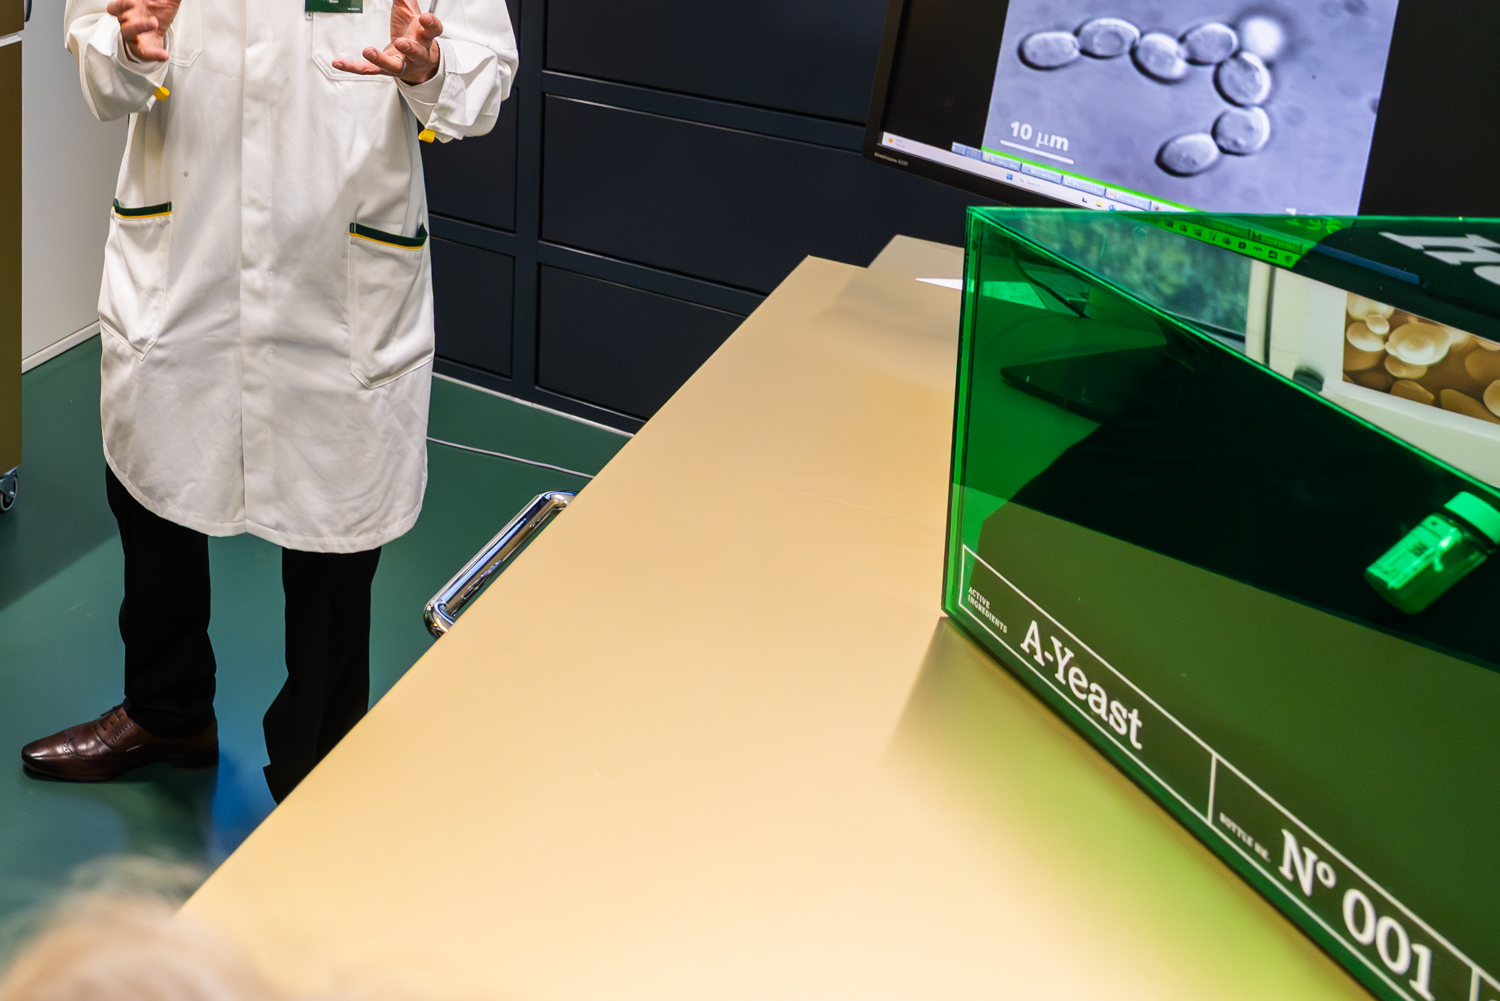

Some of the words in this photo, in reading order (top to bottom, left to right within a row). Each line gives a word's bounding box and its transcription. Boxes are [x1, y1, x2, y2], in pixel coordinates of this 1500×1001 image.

[1010, 121, 1033, 141] 10
[967, 594, 1008, 634] INGREDIENTS
[968, 586, 991, 610] ACTIVE
[1020, 620, 1143, 750] A-Yeast
[1342, 888, 1435, 1001] 001
